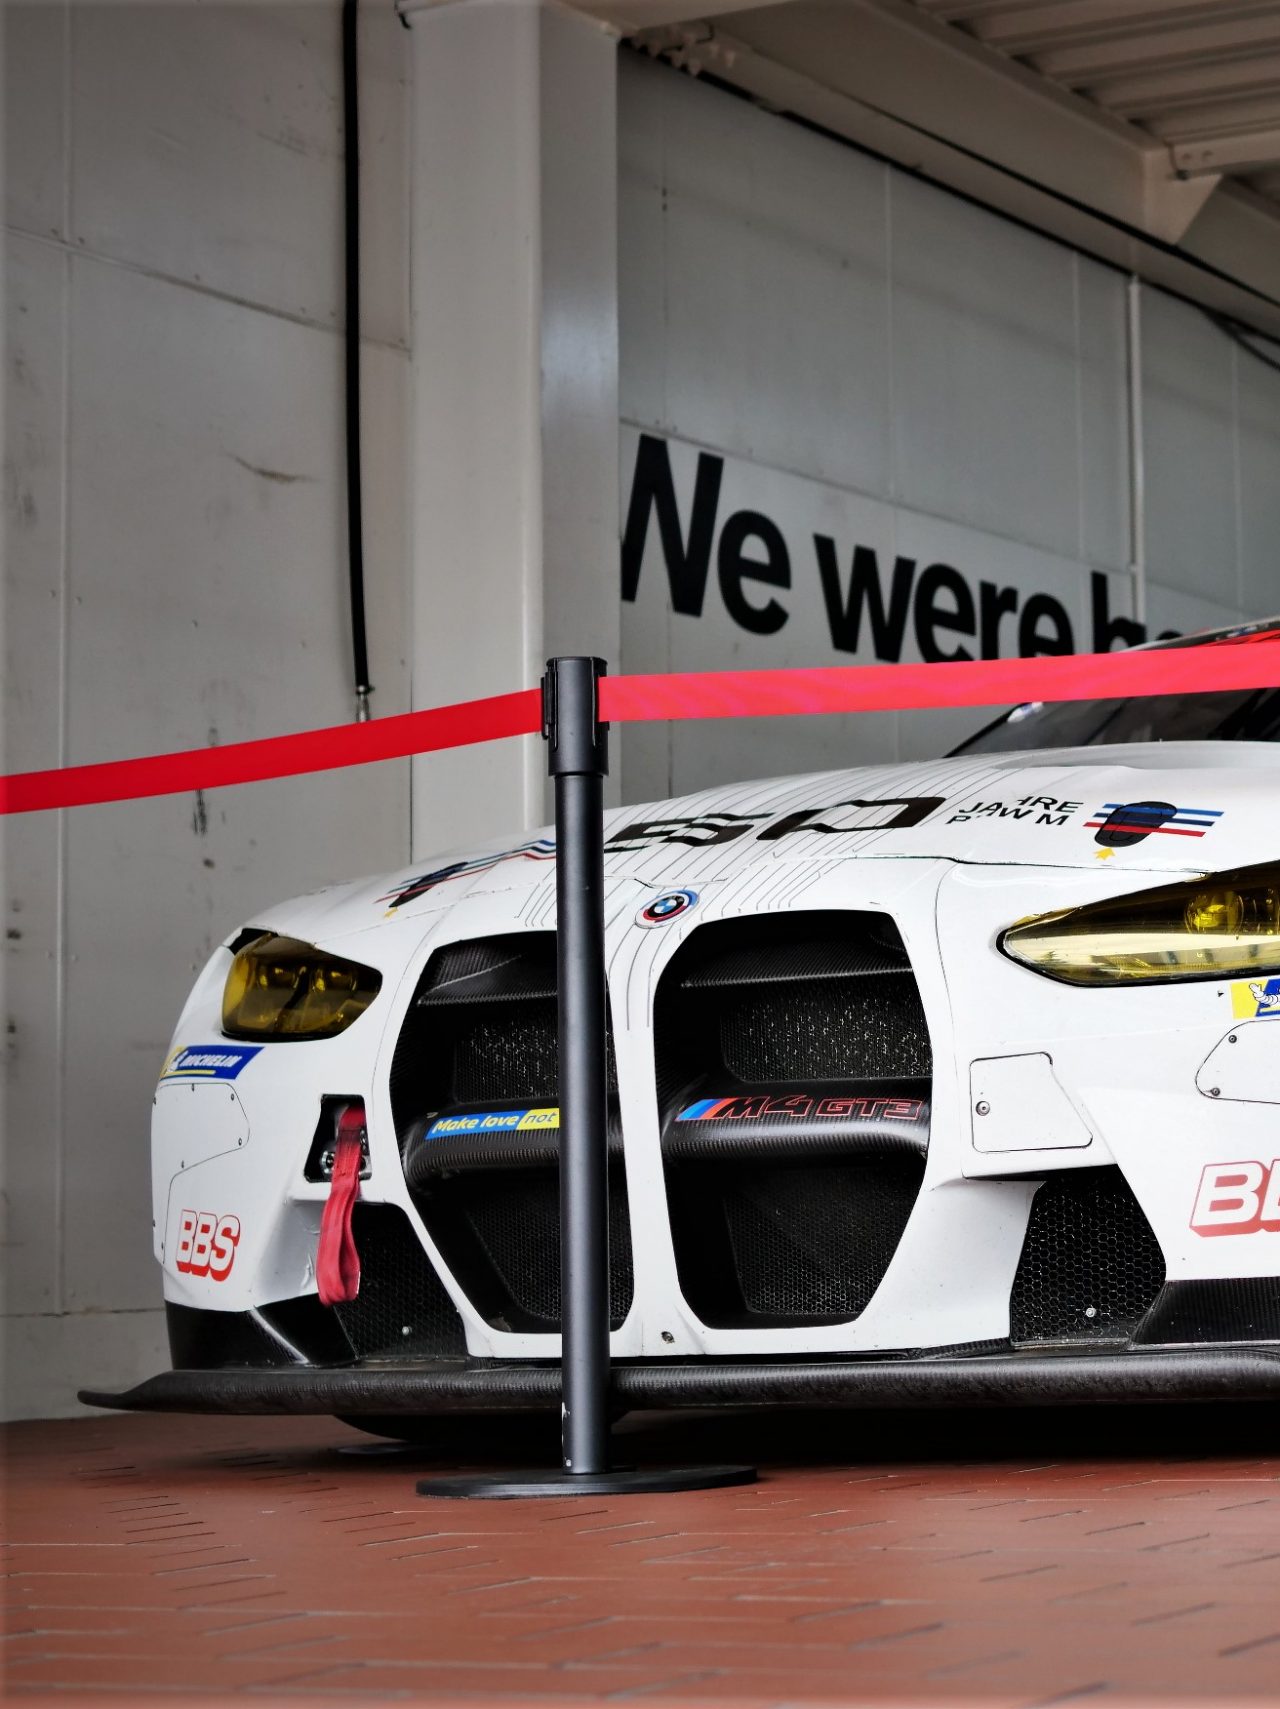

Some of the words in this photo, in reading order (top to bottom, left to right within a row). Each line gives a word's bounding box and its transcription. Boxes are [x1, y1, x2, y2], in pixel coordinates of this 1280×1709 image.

[812, 532, 1075, 664] were
[178, 1053, 243, 1069] MICHELIN
[712, 1094, 807, 1119] M4
[815, 1098, 923, 1120] GT3
[432, 1120, 477, 1134] Make
[480, 1115, 519, 1129] love
[525, 1112, 557, 1124] not
[175, 1208, 241, 1283] BBS
